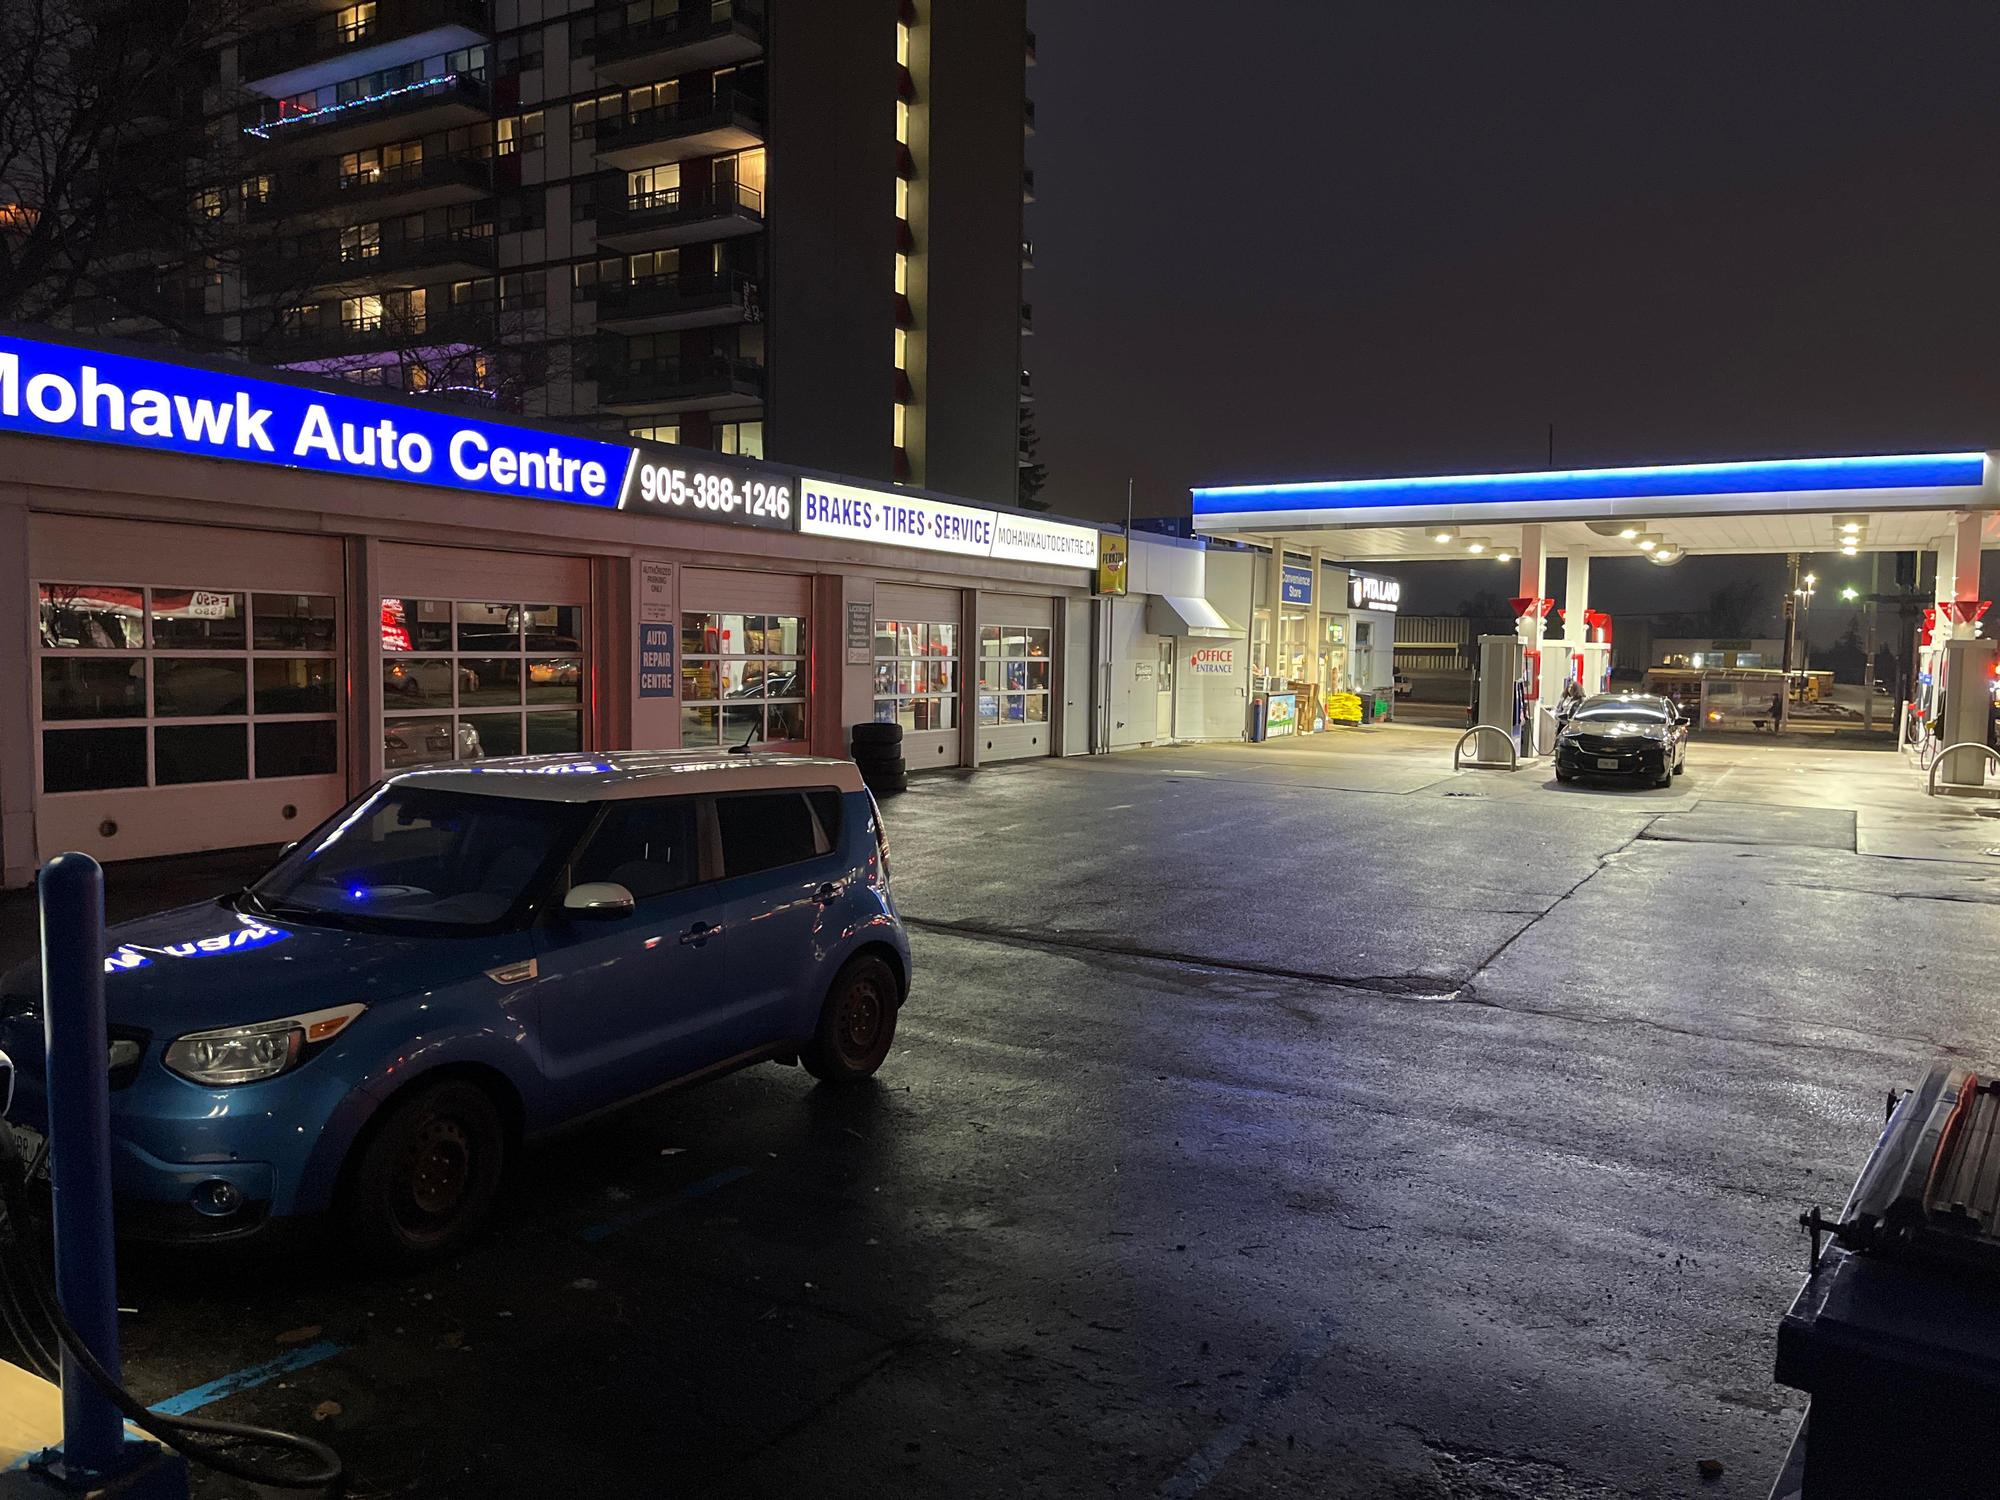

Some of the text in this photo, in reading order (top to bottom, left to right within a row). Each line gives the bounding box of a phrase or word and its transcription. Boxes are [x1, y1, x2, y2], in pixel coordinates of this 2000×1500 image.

[293, 404, 432, 473] Auto
[449, 430, 606, 496] Centre
[640, 464, 790, 520] 905-388-1246
[806, 493, 990, 544] BRAKES TIRES SERVICE
[998, 527, 1095, 556] MOHAWKAUTOCENTRE.CA
[646, 630, 667, 646] AUTO
[643, 652, 671, 667] REPAIR
[1197, 650, 1232, 662] OFFICE
[1196, 664, 1232, 673] ENTRANCE
[641, 673, 672, 689] CENTRE
